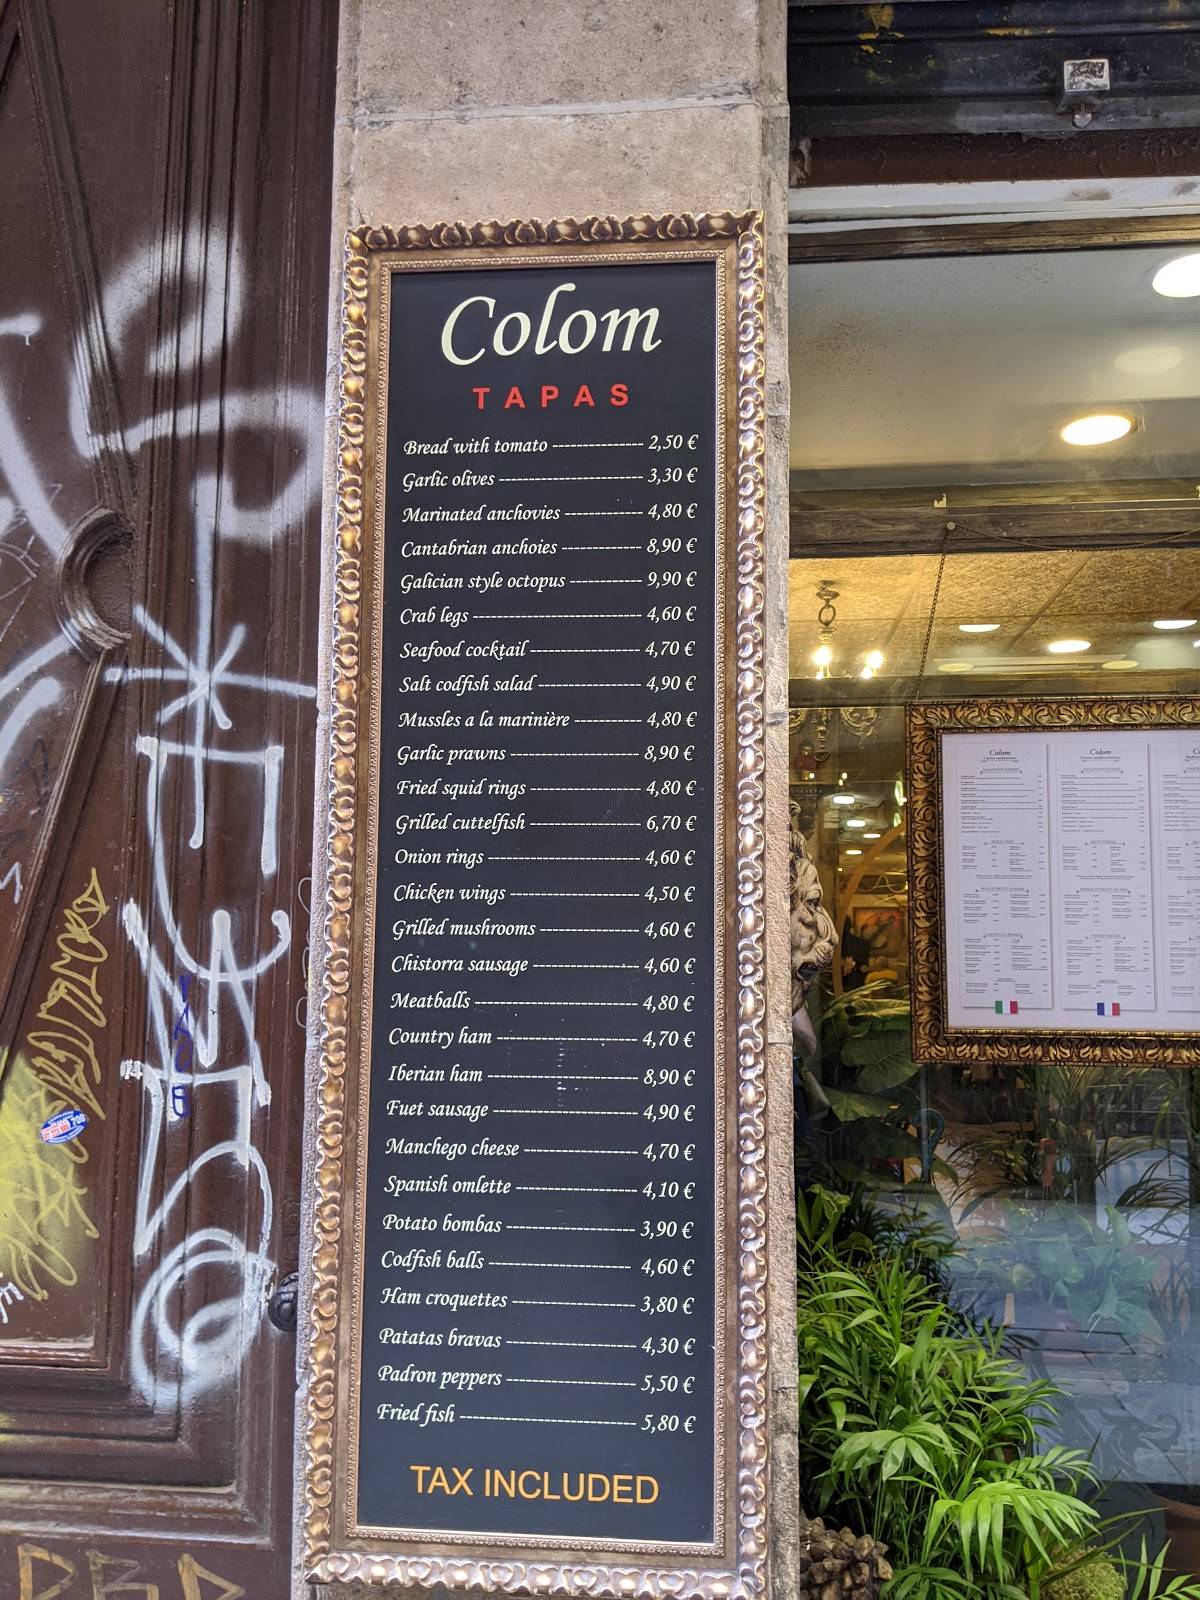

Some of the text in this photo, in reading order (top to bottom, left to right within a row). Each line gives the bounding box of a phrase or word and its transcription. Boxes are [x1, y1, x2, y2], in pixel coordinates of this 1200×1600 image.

[442, 283, 662, 365] Colom
[473, 384, 629, 409] TAPAS
[404, 435, 698, 454] Bread with tomato 2,50 €
[403, 468, 697, 492] Garlic olives 3,30 €
[402, 503, 697, 522] Marinated anchovies 4,80 €
[402, 538, 697, 557] Cantabrian anchoies 8,90 €
[401, 571, 697, 594] Galician style octopus 9,90 €
[400, 606, 696, 627] Crab legs 4,60 €
[400, 640, 695, 662] Seafood cocktail 4,70 €
[399, 675, 696, 696] Salt codfish salad 4,90 €
[399, 710, 697, 728] Mussles a la marinière 4,80 €
[398, 744, 694, 765] Garlic prawns 8,90 €
[1089, 748, 1112, 756] Colom
[397, 778, 696, 800] Fried squid rings 4,80 €
[396, 813, 696, 834] Grilled cuttelfish 6,70 €
[395, 849, 695, 869] Onion rings 4,60 €
[394, 883, 695, 905] Chicken wings 4,50 €
[393, 918, 695, 940] Grilled mushrooms 4,60 €
[392, 954, 696, 976] Chistorra sausage 4,60 €
[390, 991, 694, 1013] Meatballs 4,80 €
[389, 1026, 695, 1049] Country ham 4,70 €
[388, 1064, 695, 1087] Iberian ham 8,90 €
[387, 1100, 695, 1122] Fuet sausage 4,90 €
[385, 1137, 695, 1161] Manchego cheese 4,70 €
[384, 1174, 695, 1200] Spanish omlette 4,10 €
[383, 1214, 694, 1239] Potato bombas 3,90 €
[382, 1249, 694, 1277] Codfish balls 4,60 €
[380, 1287, 694, 1315] Ham croquettes 3,80 €
[380, 1328, 695, 1356] Patatas bravas 4,30 €
[378, 1364, 695, 1394] Padron peppers 5,50 €
[377, 1403, 696, 1433] Fried fish 5,80 €
[410, 1466, 659, 1504] TAX INCLUDED
